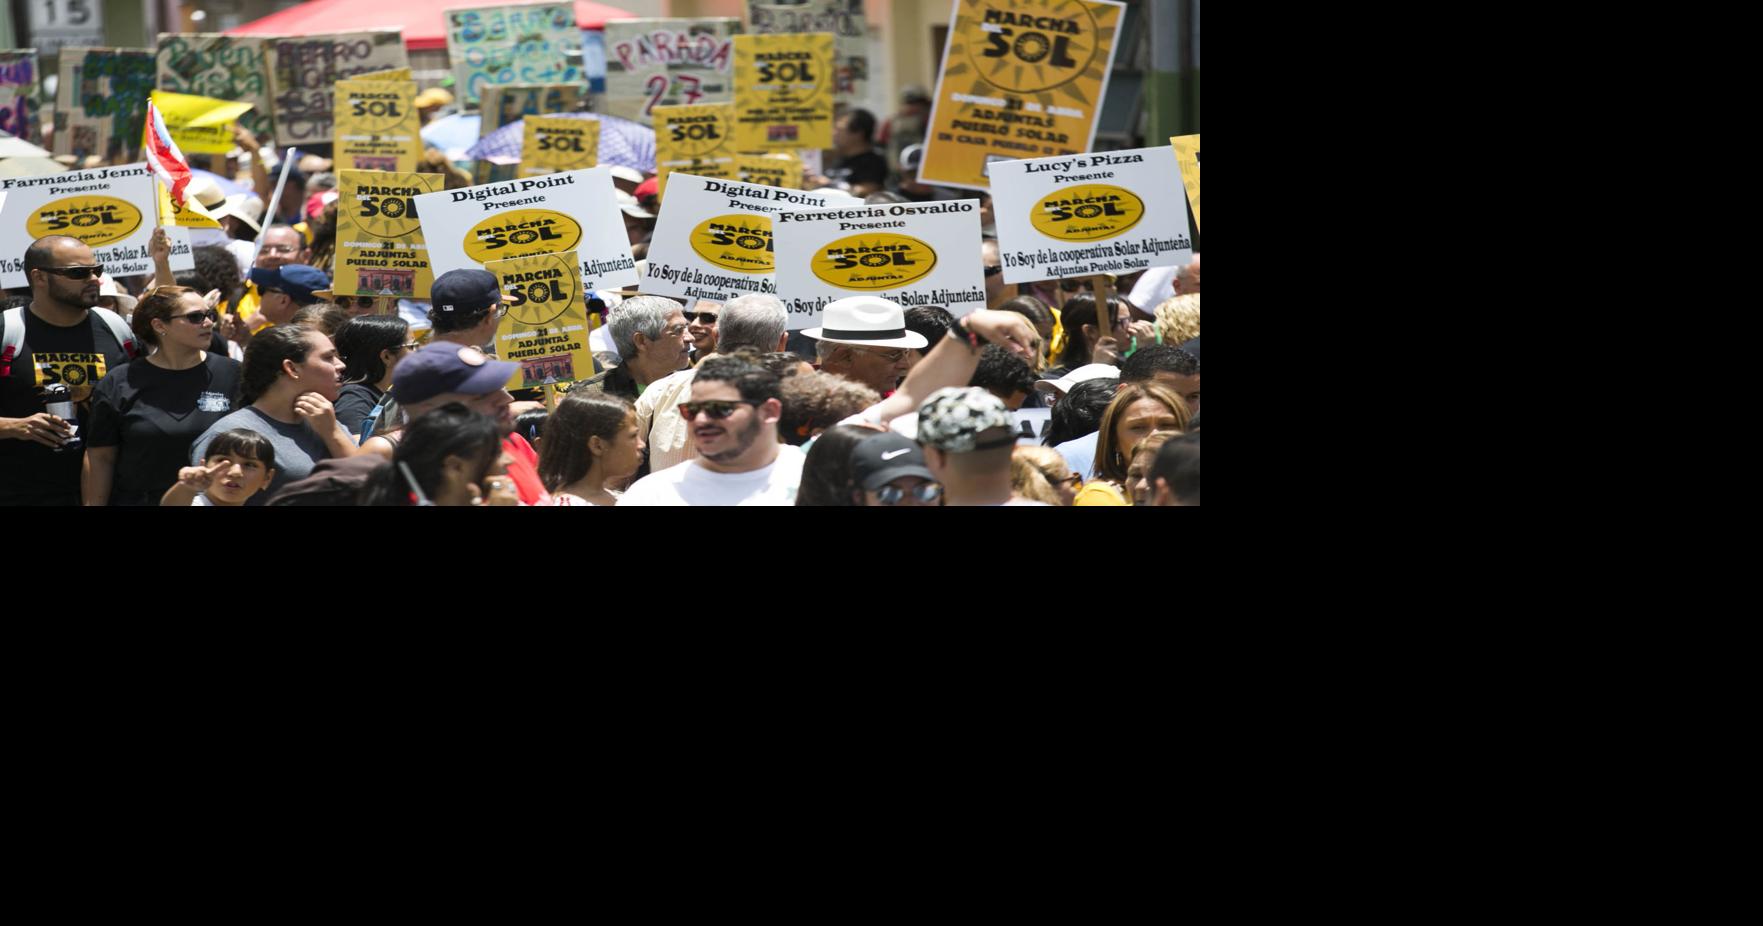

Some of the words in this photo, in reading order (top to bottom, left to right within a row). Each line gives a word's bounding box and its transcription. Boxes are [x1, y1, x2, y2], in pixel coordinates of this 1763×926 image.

[984, 9, 1081, 34] MARCHA
[615, 31, 732, 72] PARADA
[982, 27, 1077, 68] SOL
[755, 52, 812, 61] MARCHA
[757, 63, 815, 83] SOL
[645, 75, 704, 116] 27
[352, 101, 402, 116] SOL
[971, 108, 1055, 128] ADJUNTAS
[671, 124, 720, 141] SOL
[951, 119, 1010, 136] PUEBLO
[1016, 126, 1068, 144] SOLAR
[537, 136, 586, 152] SOL
[1024, 158, 1087, 174] Lucy's
[1090, 153, 1143, 166] Pizza
[2, 172, 95, 189] Farmacia
[98, 168, 152, 179] Jenn
[1054, 170, 1114, 183] Presente
[50, 183, 111, 196] Presente
[356, 186, 422, 196] MARCHA
[451, 183, 516, 201] Digital
[521, 174, 575, 192] Point
[704, 181, 769, 200] Digital
[772, 190, 826, 208] Point
[483, 194, 546, 211] Presente
[728, 200, 783, 213] Presen
[1044, 194, 1121, 208] MARCHA
[40, 205, 118, 217] MARCHA
[778, 205, 885, 223] Ferreteria
[889, 202, 973, 216] Osvaldo
[1050, 202, 1125, 222] SOL
[47, 211, 123, 230] SOL
[477, 219, 556, 236] MARCHA
[839, 220, 906, 231] Presente
[485, 227, 562, 250] SOL
[709, 223, 773, 237] MARCH
[360, 250, 417, 259] ADJUNTAS
[382, 242, 394, 250] 21
[827, 244, 912, 256] MARCHA
[1003, 253, 1017, 267] Yo
[1018, 251, 1036, 268] Soy
[1037, 249, 1048, 264] de
[1048, 248, 1058, 262] la
[1059, 244, 1115, 264] cooperativa
[1114, 241, 1140, 256] Solar
[1142, 234, 1190, 256] Adjunteña
[1, 260, 13, 273] Yo
[14, 258, 25, 273] So
[113, 246, 141, 263] Solar
[123, 263, 148, 273] Solar
[346, 258, 388, 267] PUEBLO
[392, 260, 428, 268] SOLAR
[583, 254, 635, 278] Adjunteña
[834, 252, 916, 270] SOL
[502, 269, 562, 284] MARCHA
[648, 263, 661, 279] Yo
[661, 264, 680, 285] Soy
[681, 267, 692, 283] de
[693, 269, 702, 284] la
[703, 275, 759, 292] cooperativa
[1046, 267, 1089, 279] Adjuntas
[1091, 262, 1121, 273] Pueblo
[1123, 259, 1149, 269] Solar
[509, 280, 567, 307] SOL
[684, 286, 728, 301] Adjuntas
[794, 297, 814, 317] Soy
[816, 296, 827, 312] de
[901, 290, 930, 306] Solar
[931, 286, 985, 307] Adjunteña
[537, 328, 548, 337] 21
[518, 335, 569, 348] ADJUNTAS
[34, 354, 103, 363] MARCHA
[508, 347, 546, 359] PUEBLO
[550, 342, 581, 354] SOLAR
